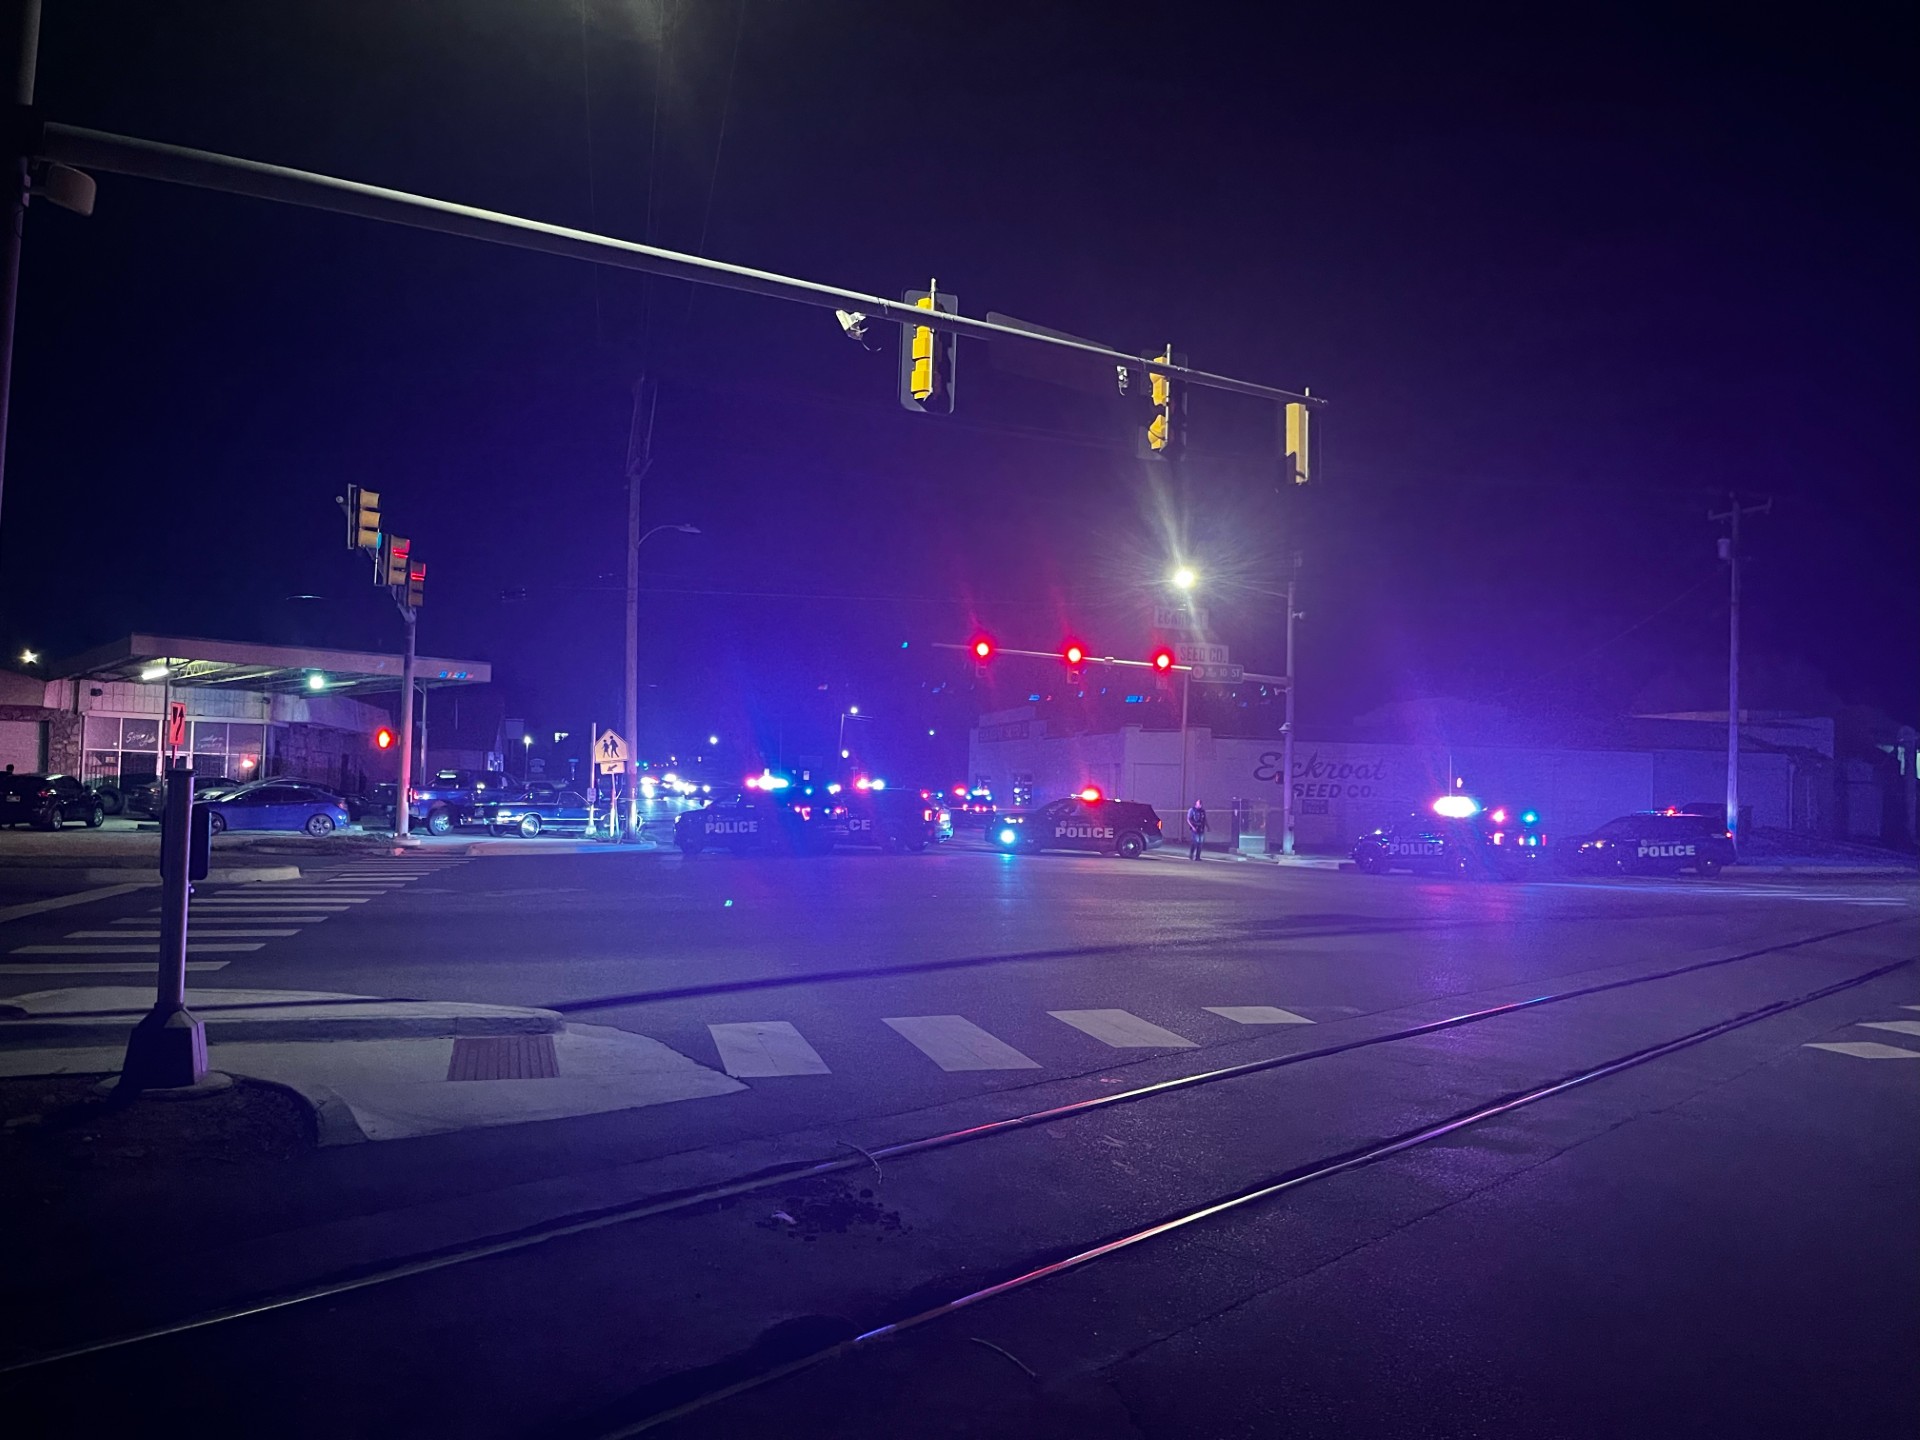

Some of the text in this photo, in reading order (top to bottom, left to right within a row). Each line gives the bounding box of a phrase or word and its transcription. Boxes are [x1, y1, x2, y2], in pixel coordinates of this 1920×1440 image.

[1180, 646, 1205, 662] SEED
[1231, 668, 1240, 678] ST
[1292, 783, 1342, 798] SEED
[705, 821, 758, 834] POLICE
[1055, 827, 1114, 838] POLICE
[1389, 843, 1443, 856] POLICE
[1637, 845, 1696, 858] POLICE
